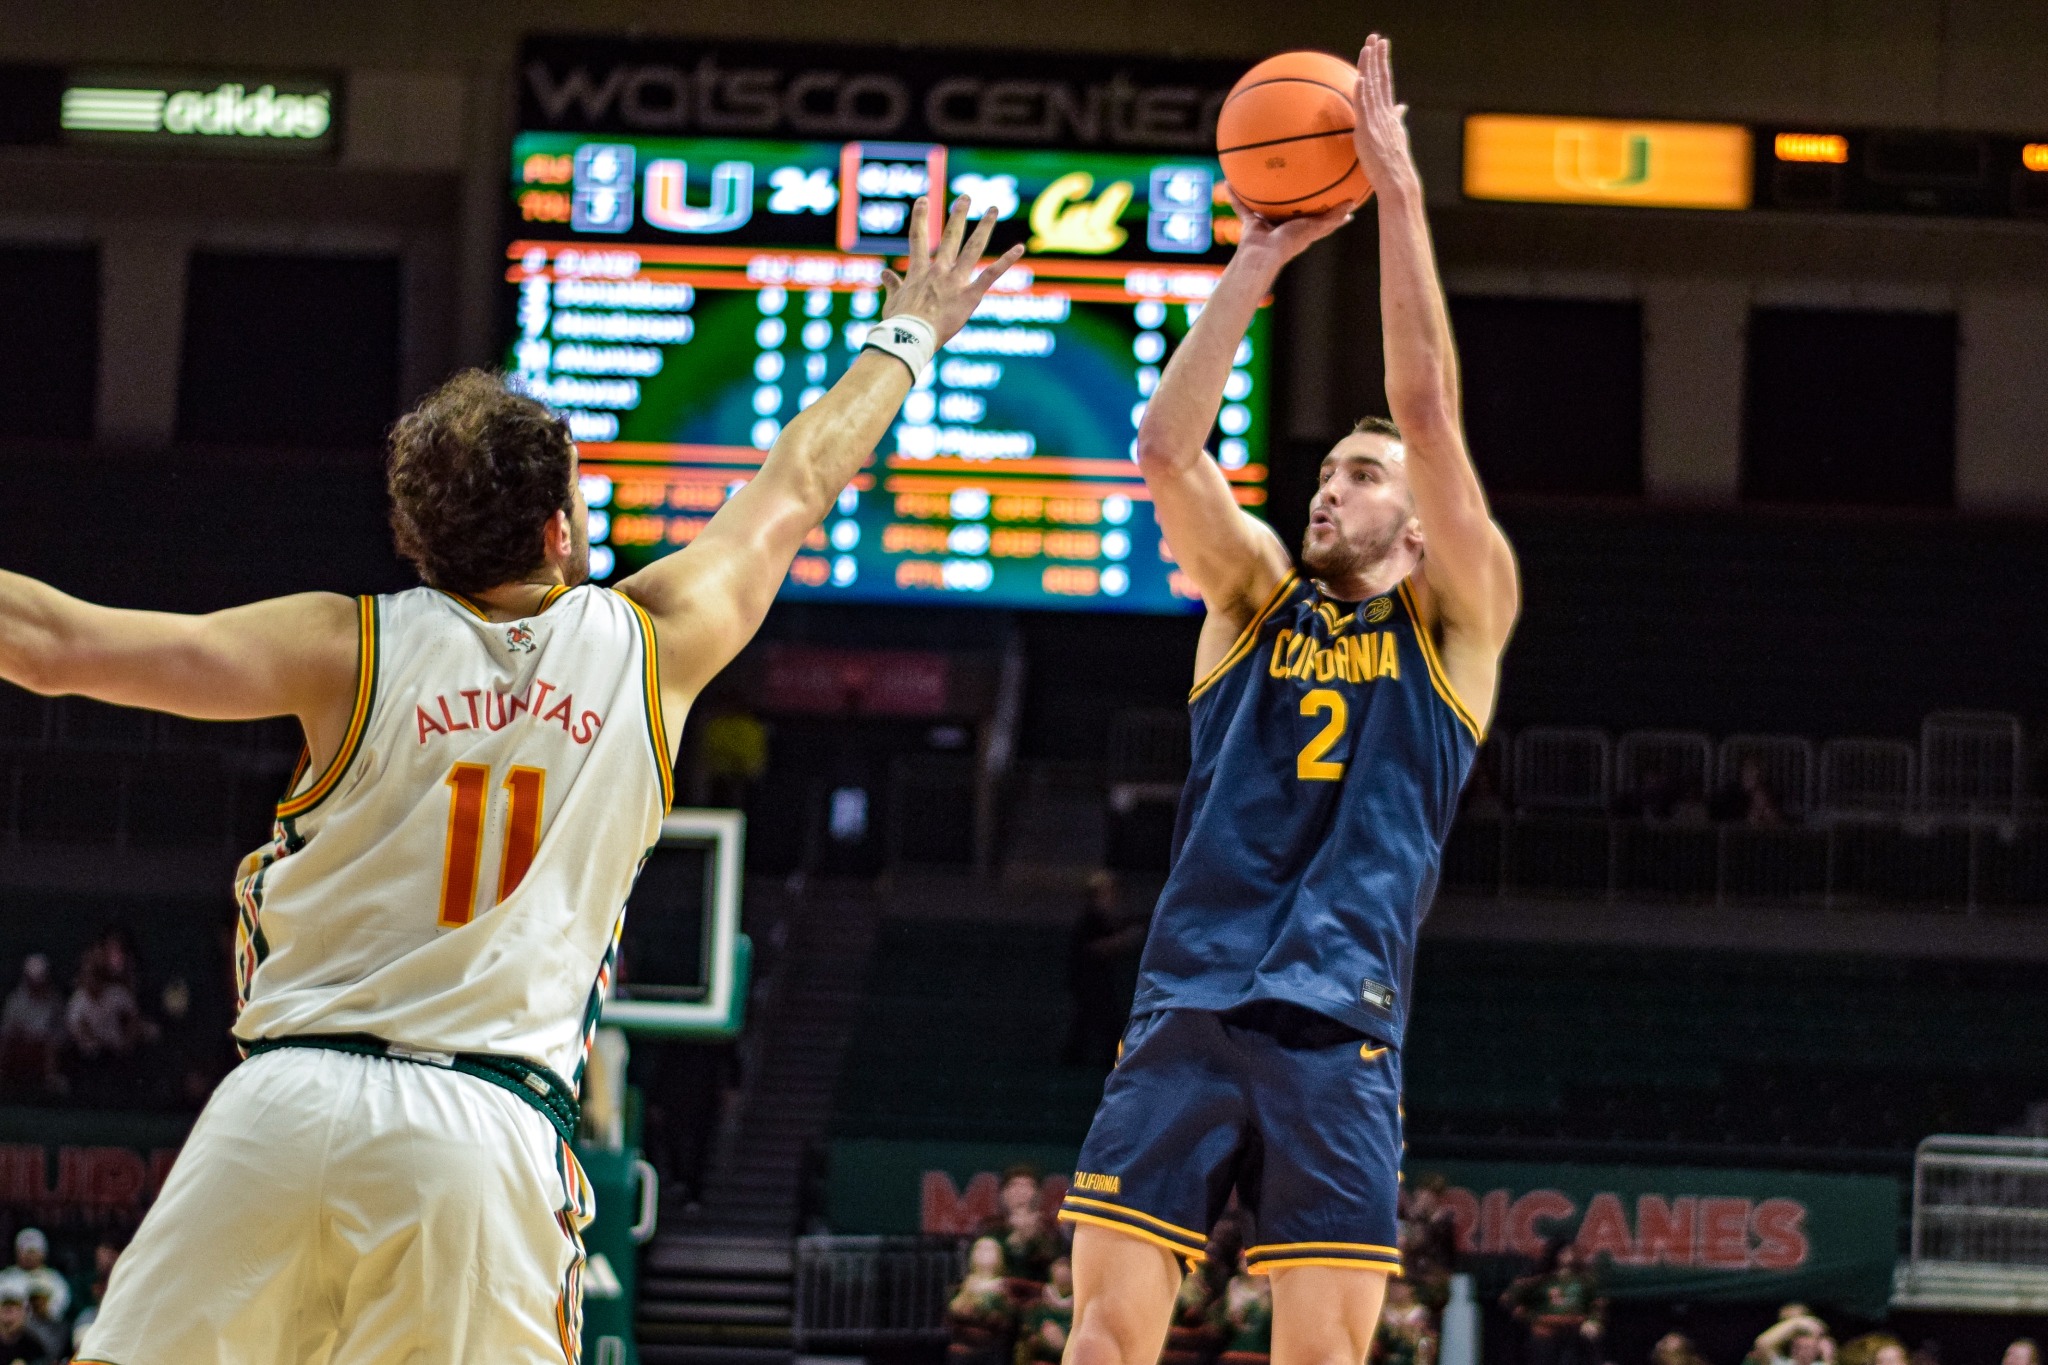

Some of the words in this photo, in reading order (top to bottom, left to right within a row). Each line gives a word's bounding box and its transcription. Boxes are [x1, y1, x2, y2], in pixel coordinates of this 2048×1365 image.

[162, 84, 331, 139] adidas
[416, 678, 602, 746] ALTUNTAS
[1296, 688, 1347, 780] 2
[437, 760, 547, 929] 11
